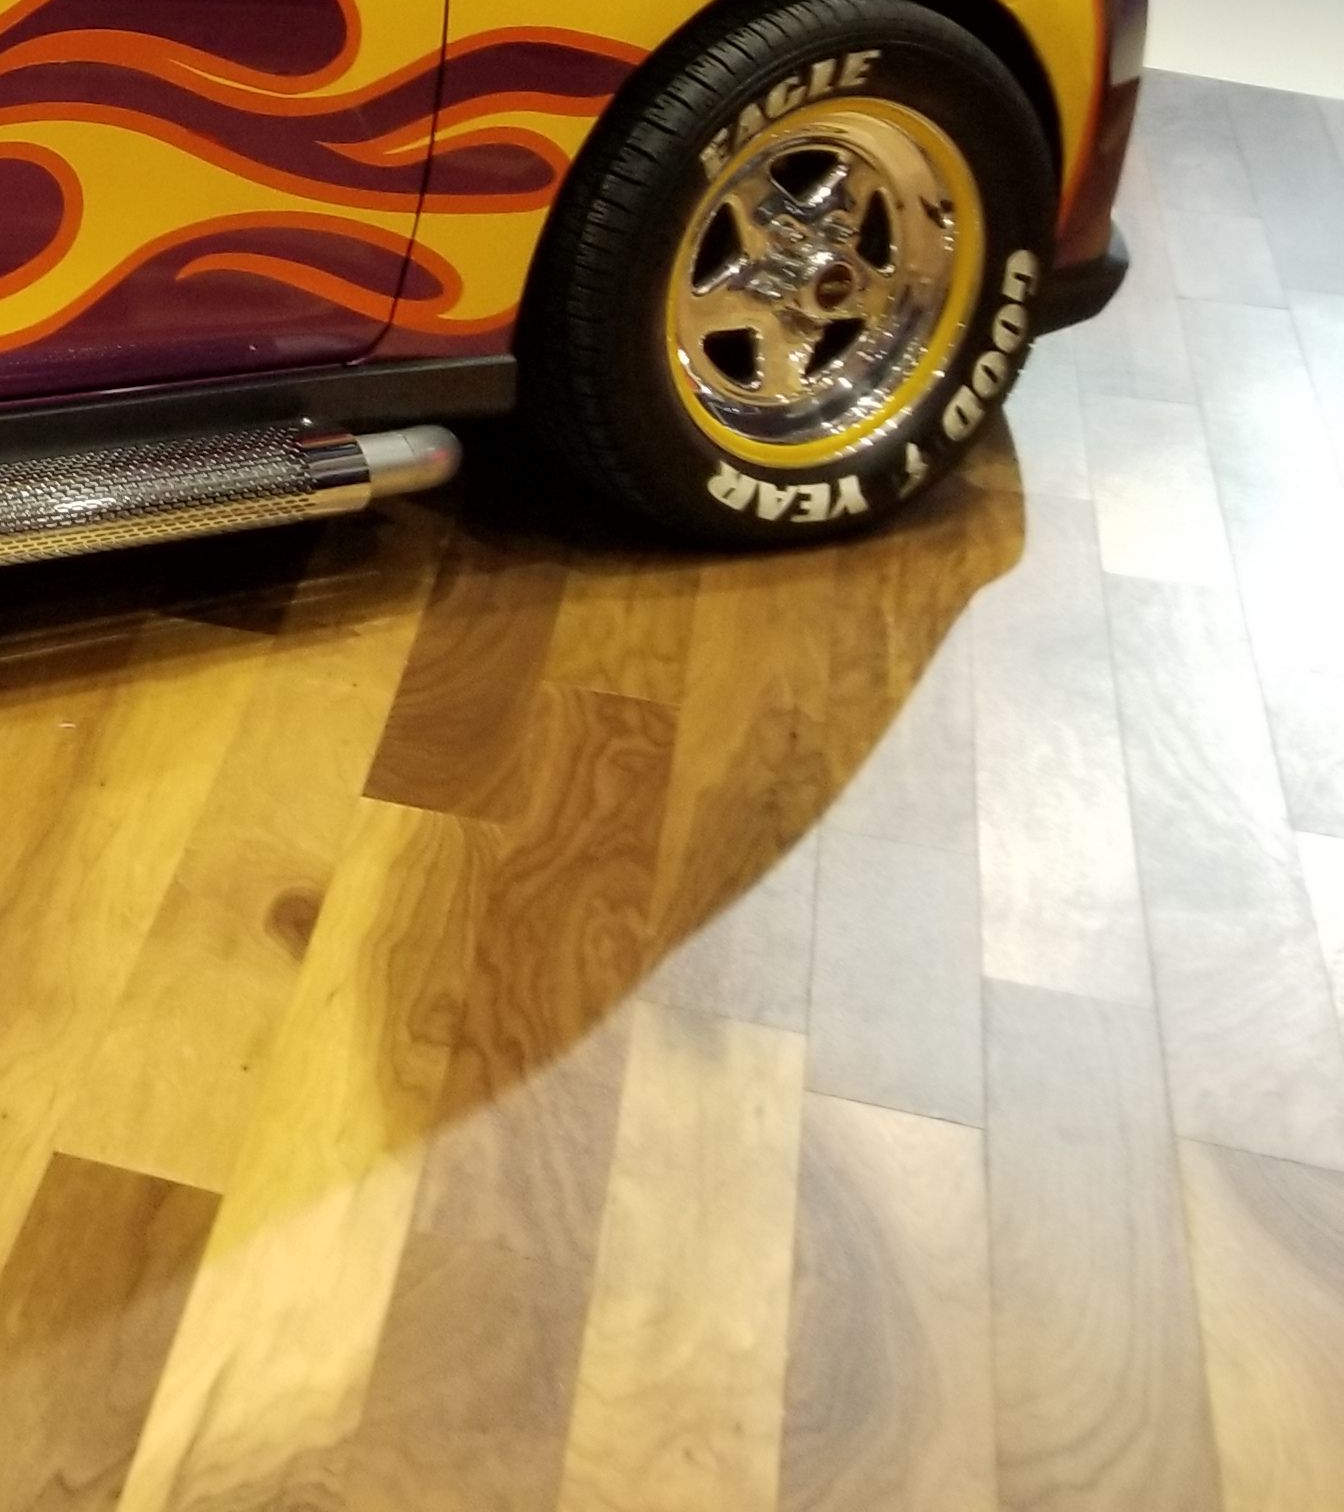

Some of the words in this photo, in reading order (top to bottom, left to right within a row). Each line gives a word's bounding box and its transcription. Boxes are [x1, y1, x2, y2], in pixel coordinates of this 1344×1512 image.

[698, 49, 881, 180] EAGLE
[942, 250, 1039, 442] GOOD
[707, 460, 869, 522] YEAR
